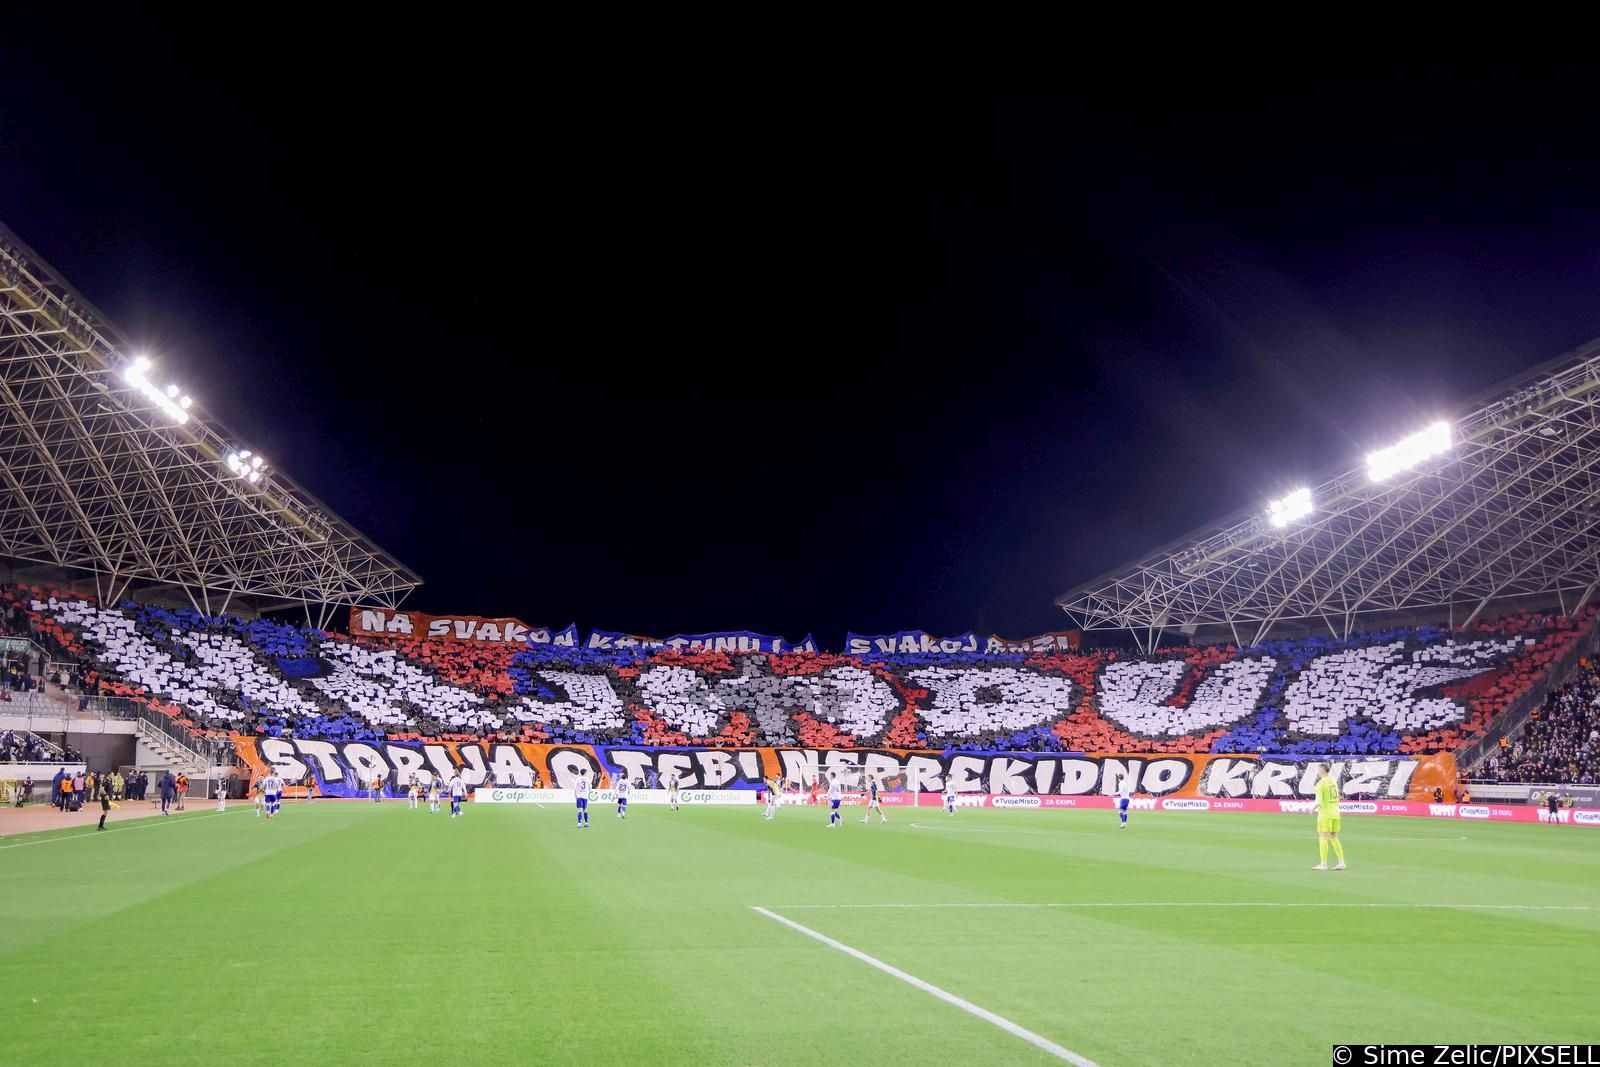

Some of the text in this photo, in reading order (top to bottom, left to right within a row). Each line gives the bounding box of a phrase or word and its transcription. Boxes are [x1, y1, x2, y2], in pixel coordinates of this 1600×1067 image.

[361, 610, 414, 634] NA
[851, 634, 977, 655] SVAKOJ
[261, 737, 536, 789] STORIJA
[611, 750, 759, 790] TEBI
[783, 750, 1188, 796] NEPREKIDNO
[995, 797, 1039, 805] #TvojeMisto
[1165, 801, 1208, 809] #TvojeMisto
[1338, 803, 1375, 812] vojeMisto
